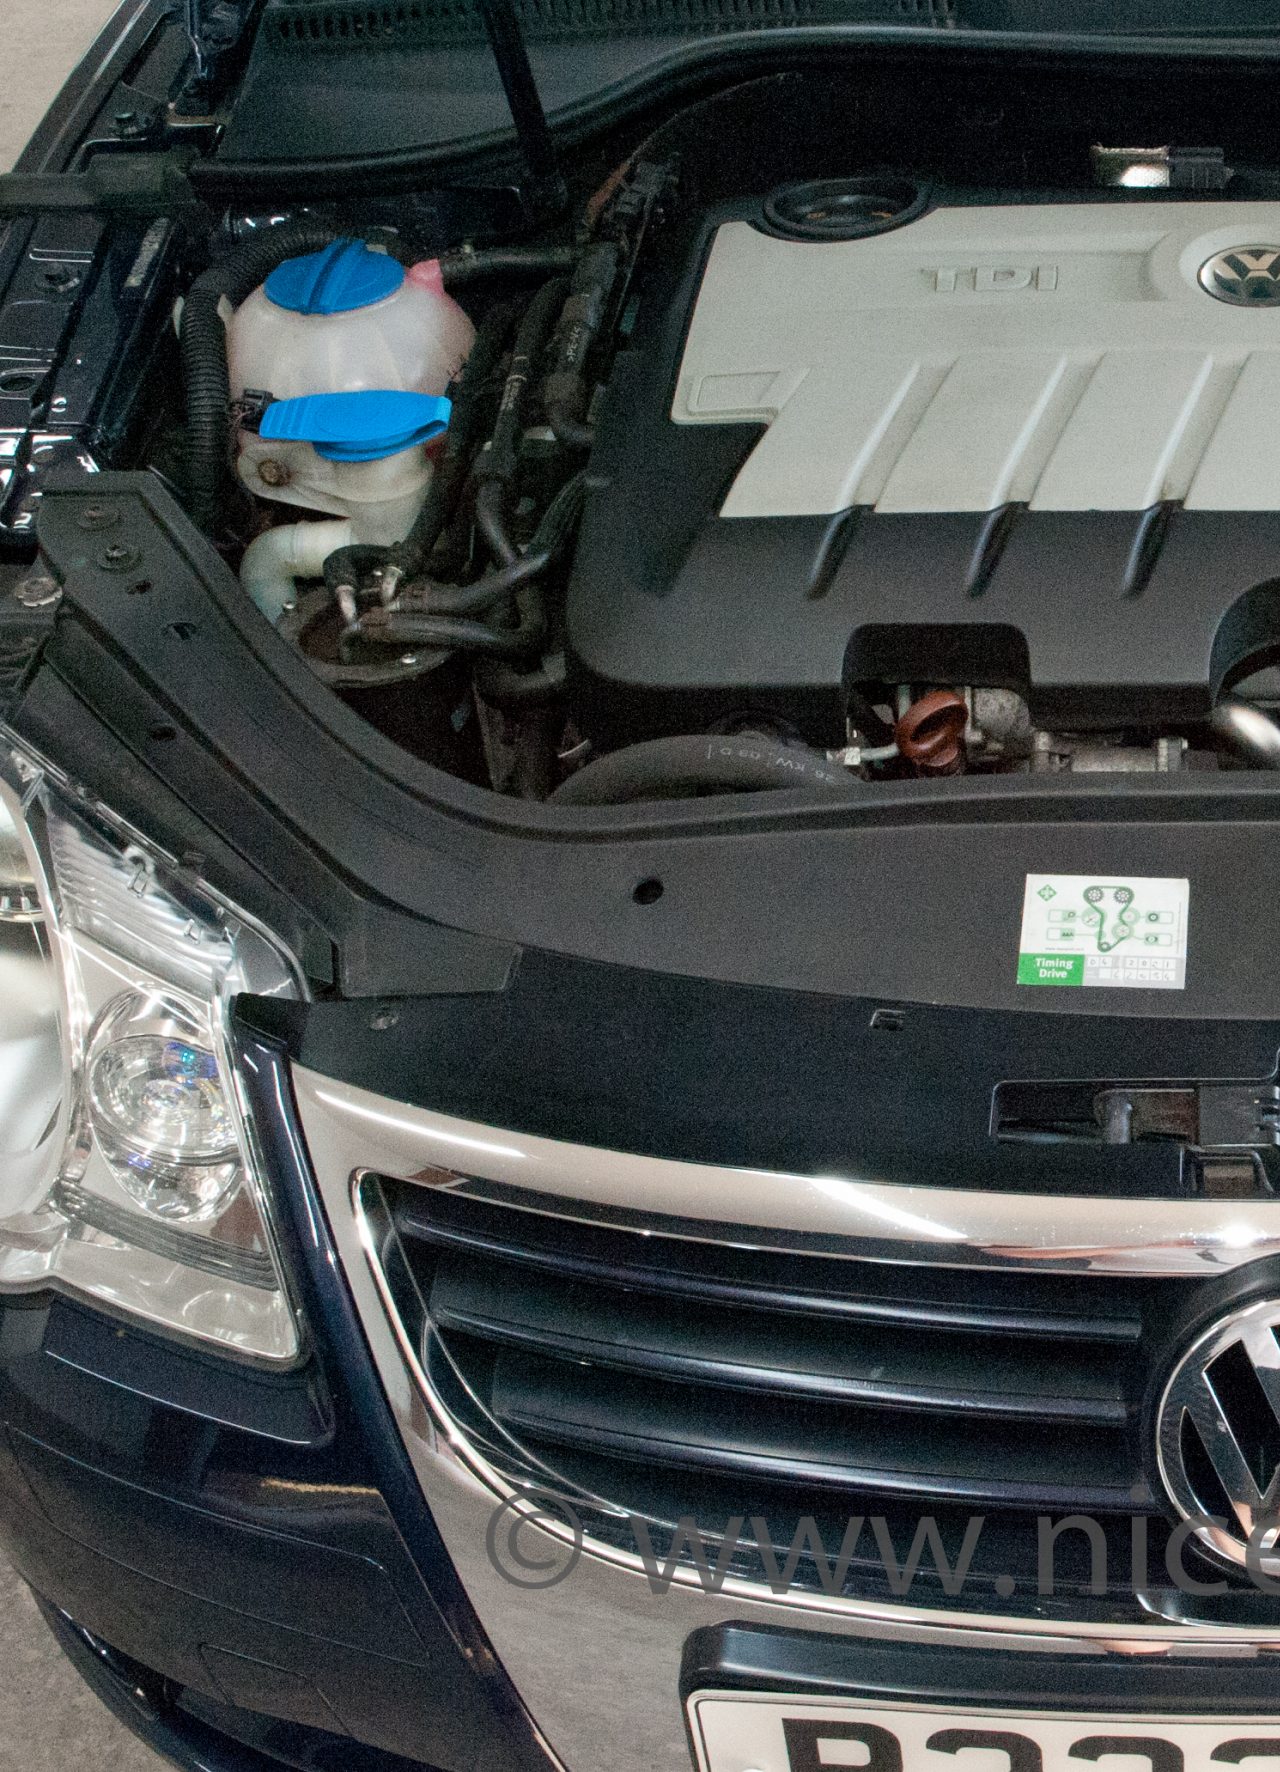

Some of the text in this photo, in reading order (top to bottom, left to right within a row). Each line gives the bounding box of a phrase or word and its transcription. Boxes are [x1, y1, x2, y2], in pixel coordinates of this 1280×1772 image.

[918, 265, 1059, 292] TDI
[1035, 957, 1075, 970] Timing
[1038, 968, 1068, 979] Drive
